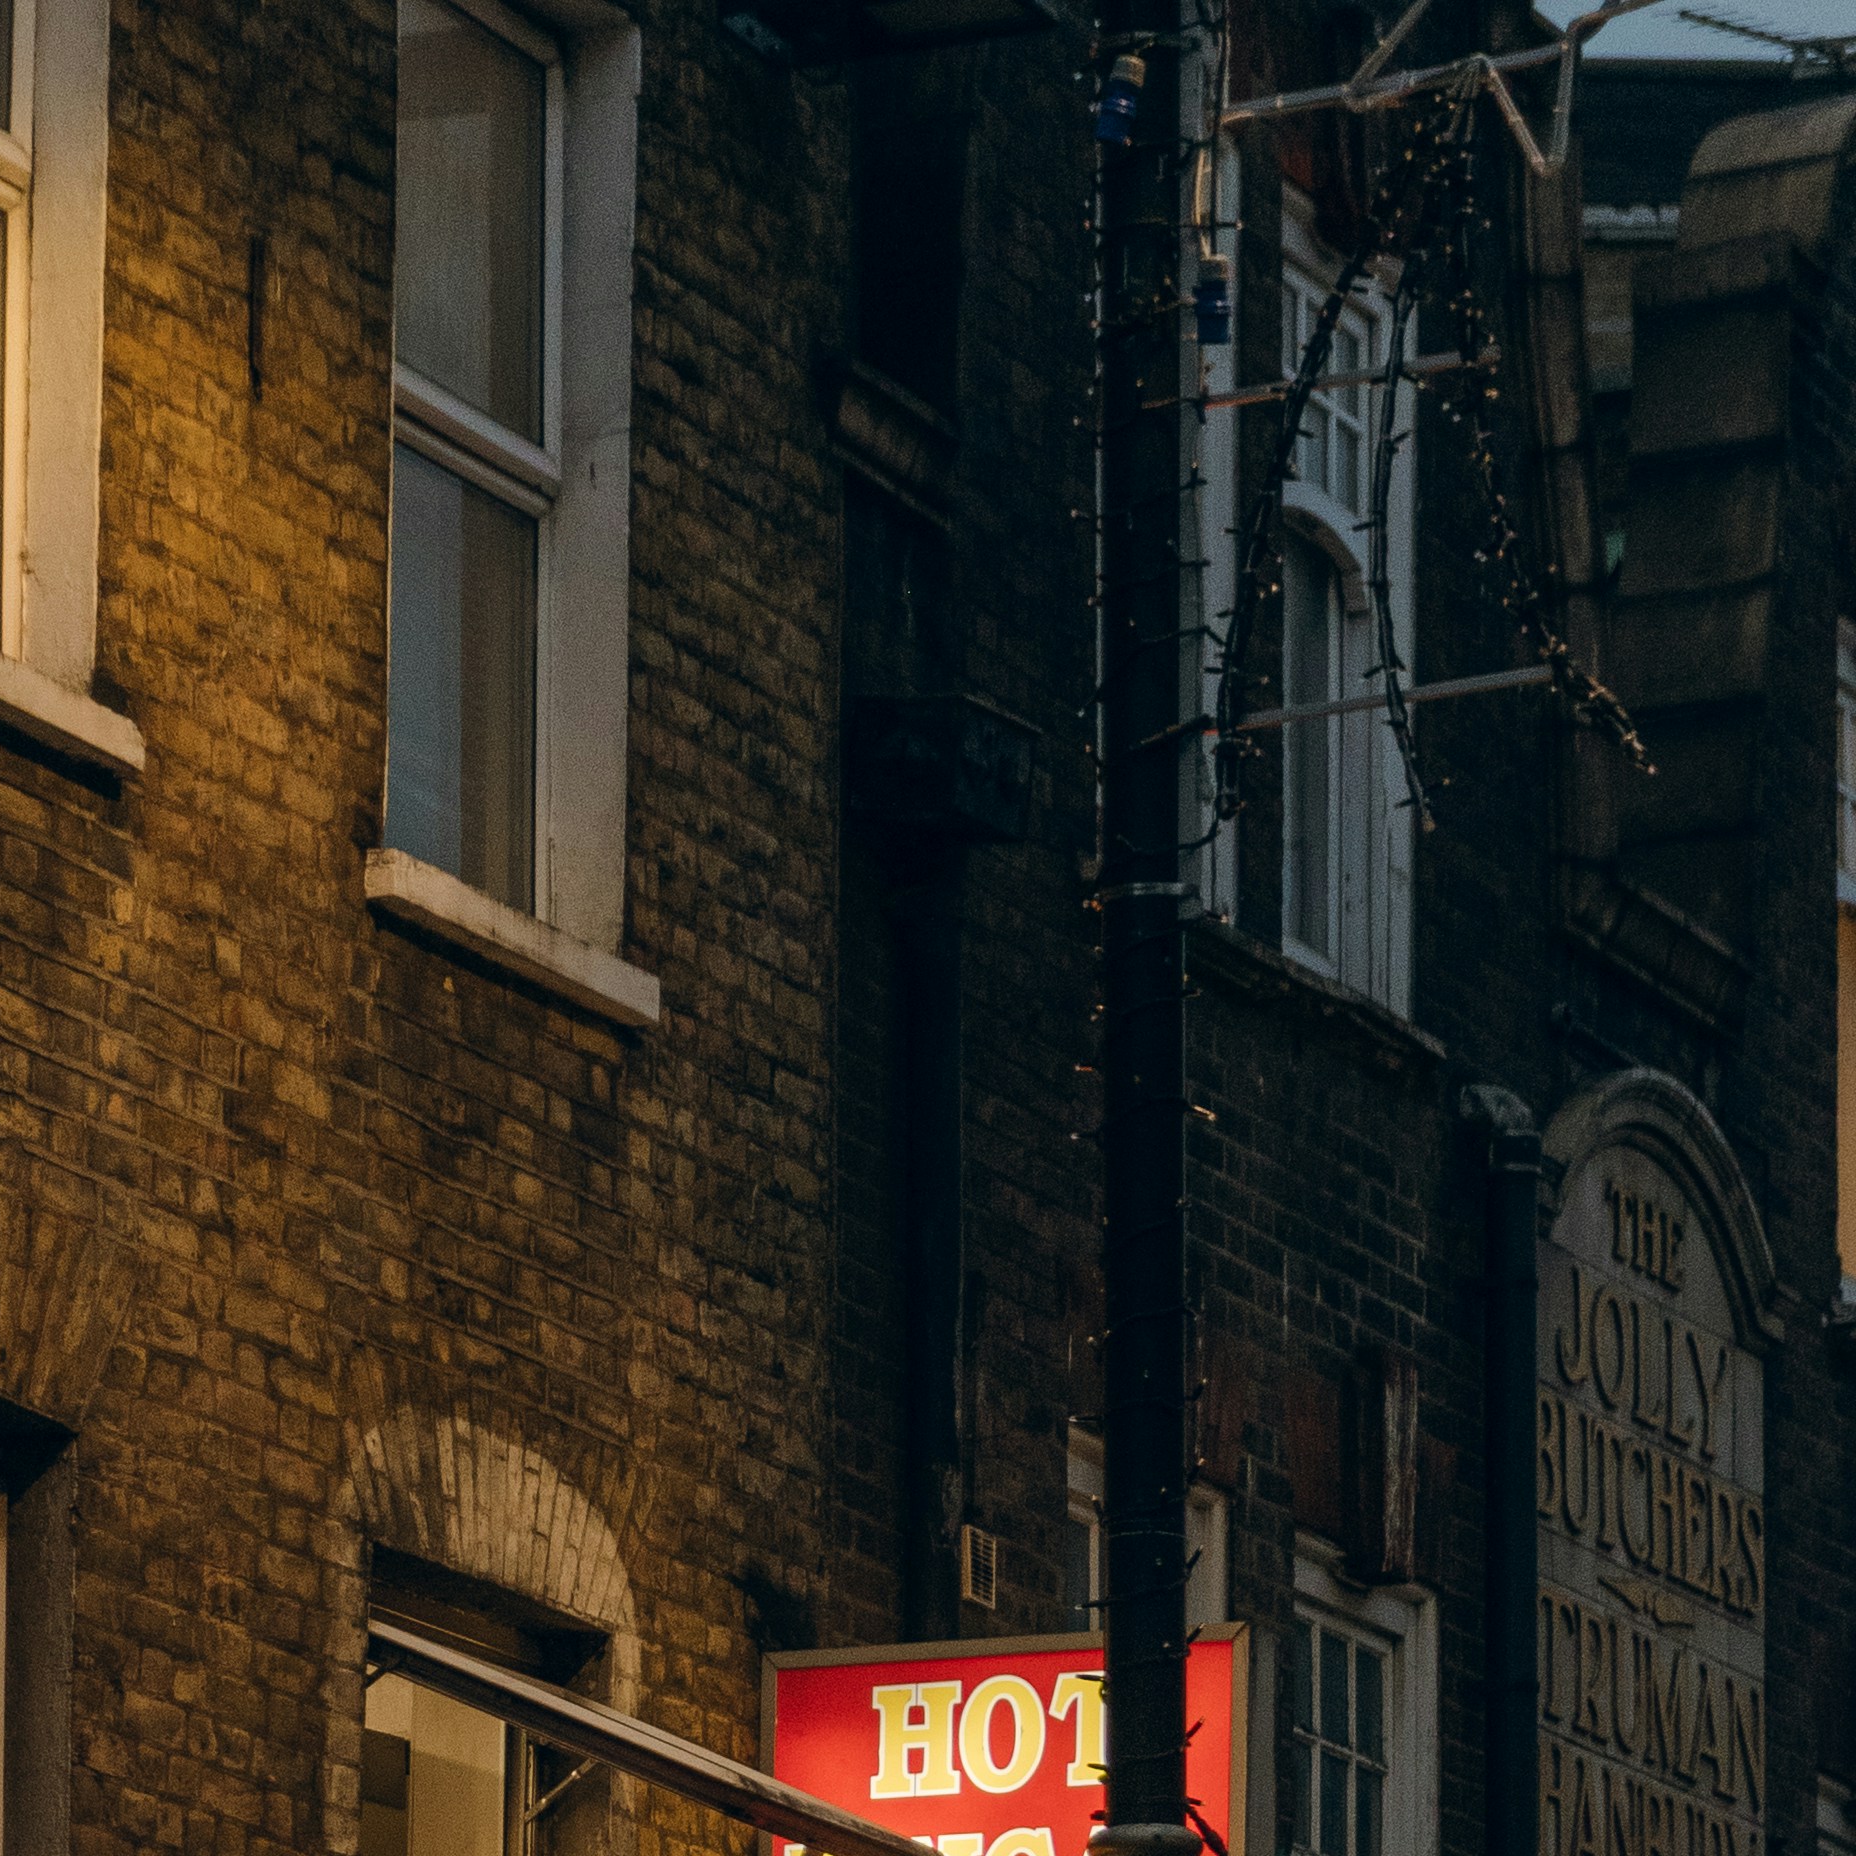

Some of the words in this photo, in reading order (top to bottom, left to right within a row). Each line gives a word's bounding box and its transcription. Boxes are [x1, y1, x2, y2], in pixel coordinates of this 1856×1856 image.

[1605, 1178, 1685, 1293] THE
[1555, 1267, 1728, 1461] JOLLY
[1537, 1397, 1764, 1620] BUTCHERS
[1538, 1592, 1764, 1814] TRUMAN
